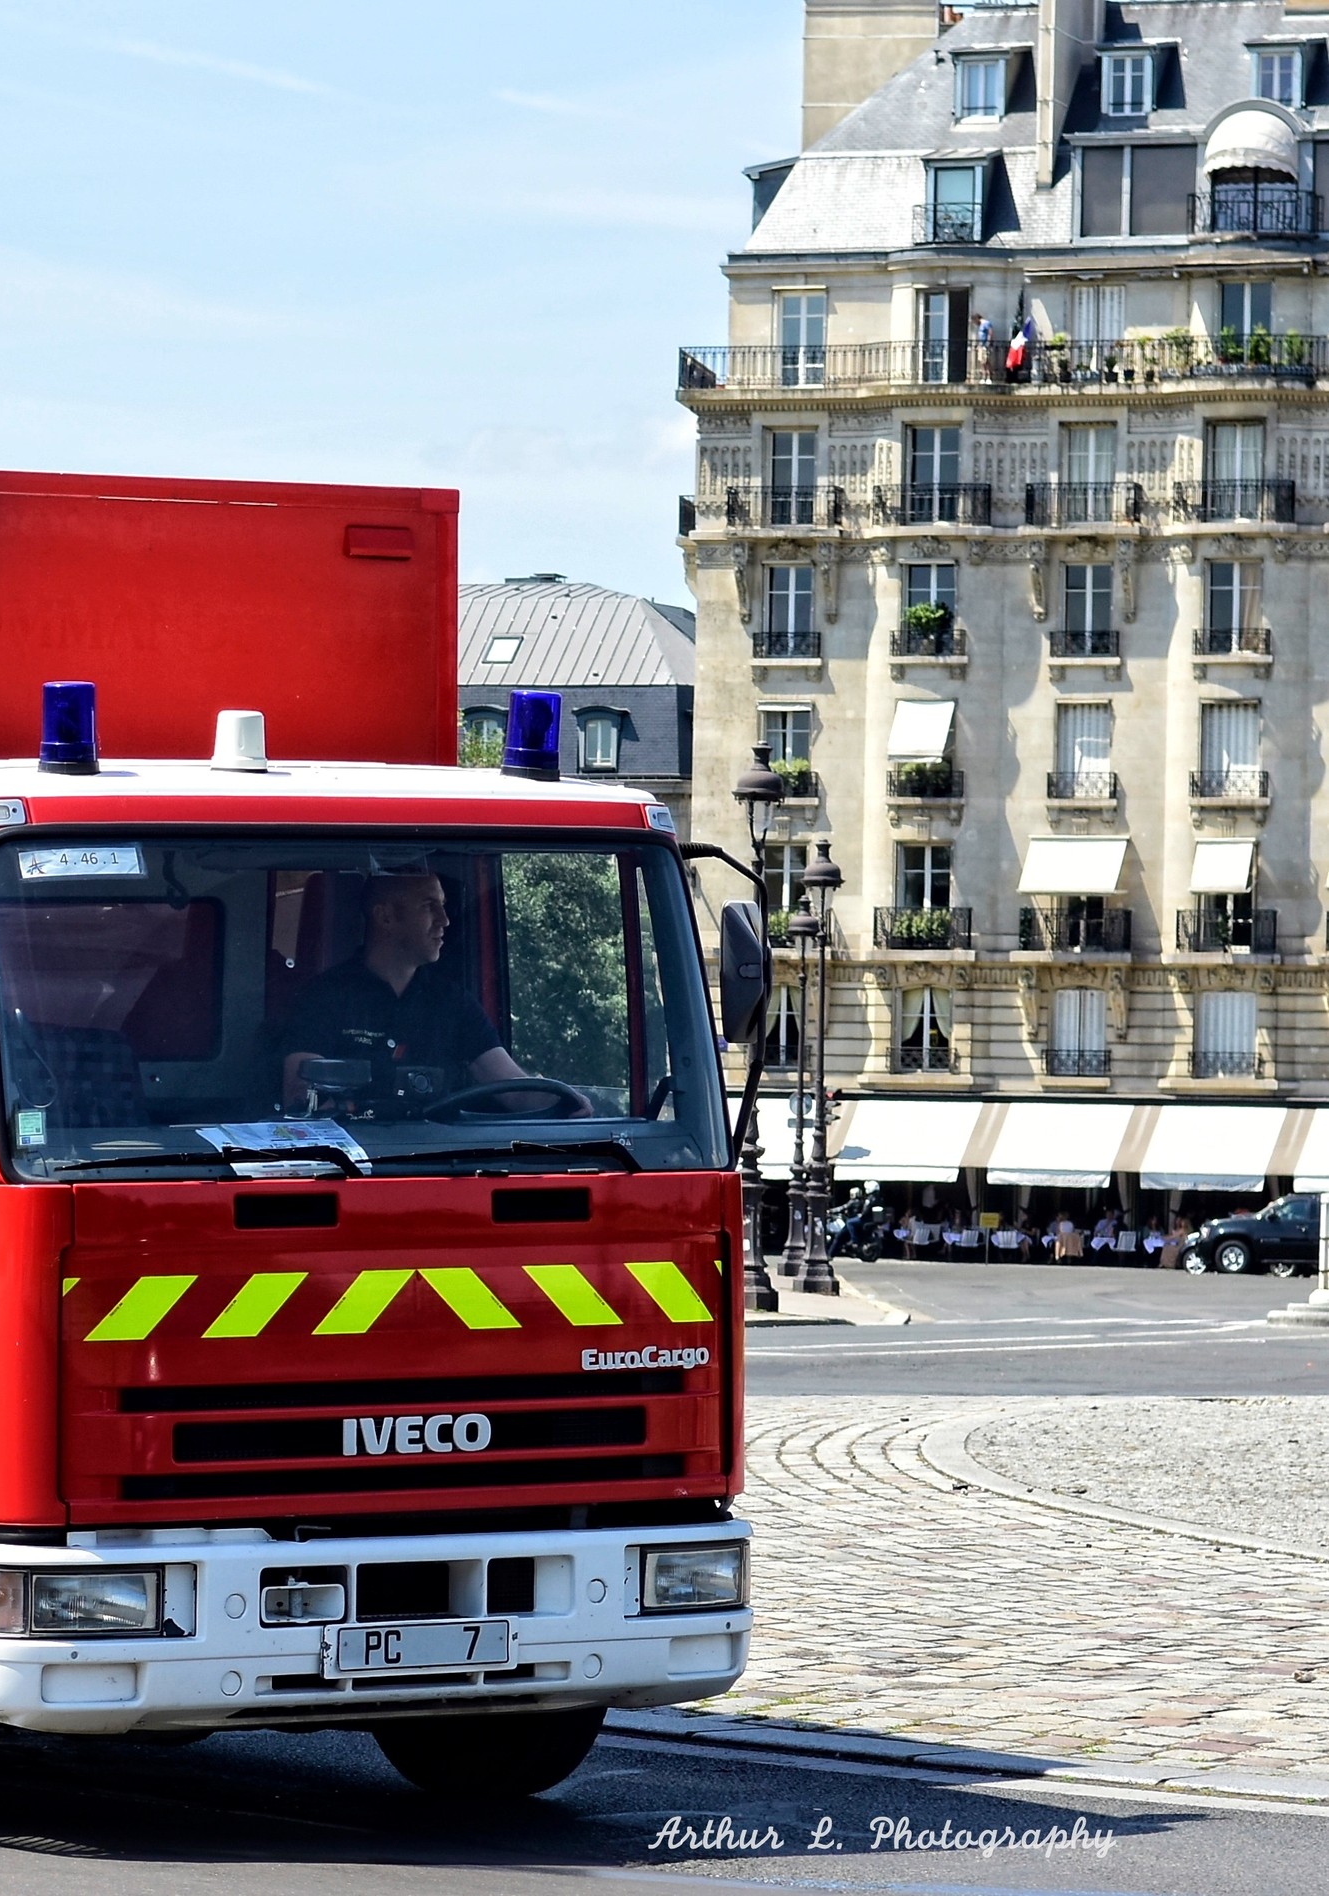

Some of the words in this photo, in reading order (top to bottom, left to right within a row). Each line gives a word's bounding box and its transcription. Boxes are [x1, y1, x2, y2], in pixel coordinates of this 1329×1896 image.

[581, 1345, 710, 1371] EuroCargo
[342, 1413, 492, 1457] IVECO
[364, 1629, 402, 1666] PC
[462, 1625, 481, 1661] 7
